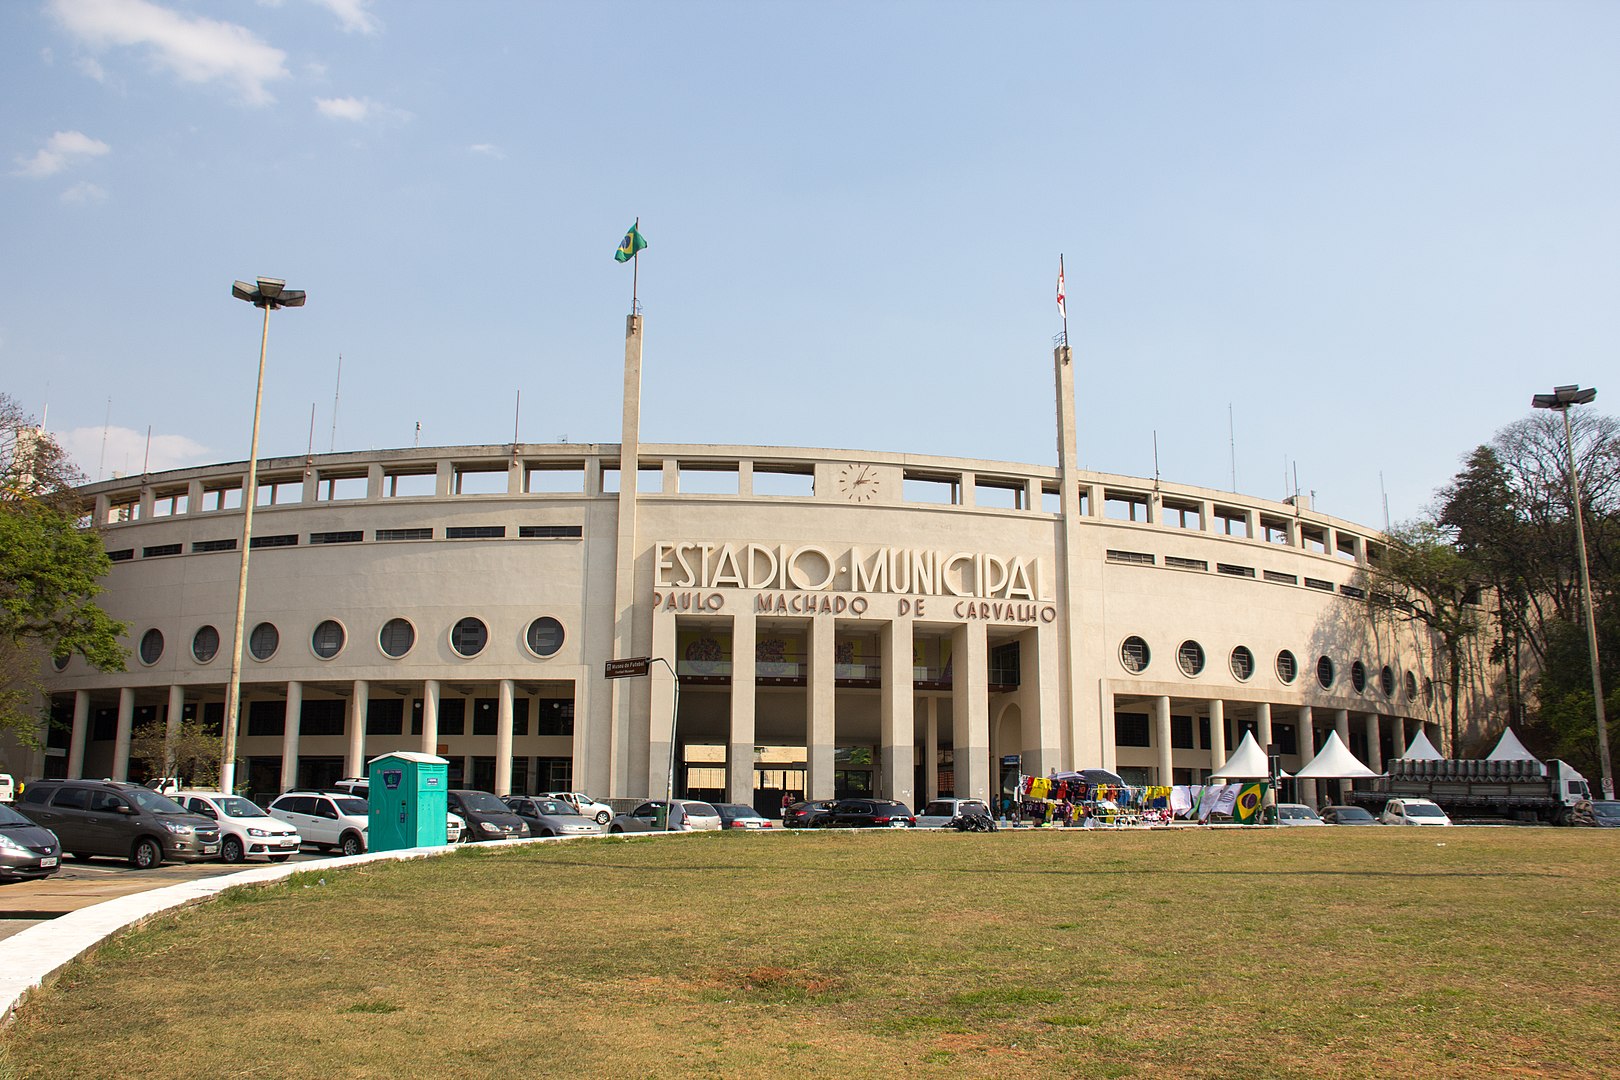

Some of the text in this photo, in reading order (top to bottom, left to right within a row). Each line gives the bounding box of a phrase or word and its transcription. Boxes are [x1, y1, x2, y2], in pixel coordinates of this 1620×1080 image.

[654, 541, 1056, 602] ESTADIO MUNICIPAL
[653, 591, 1056, 623] PAULO MACHADO DE CARVALHO
